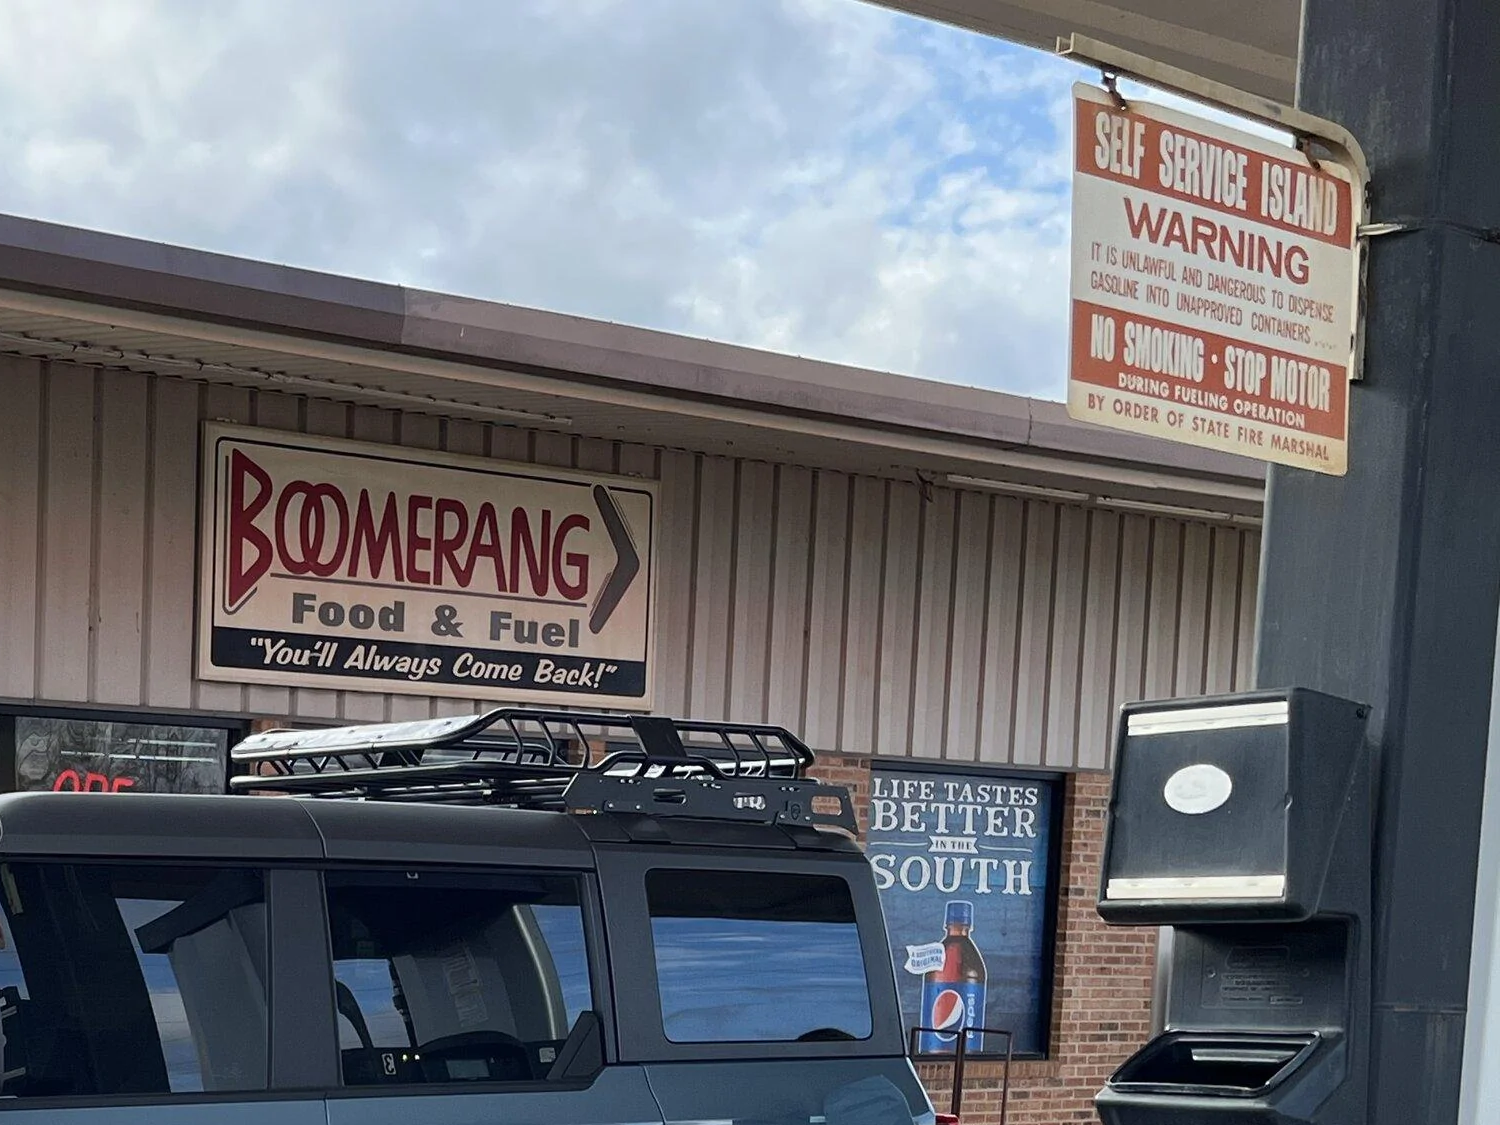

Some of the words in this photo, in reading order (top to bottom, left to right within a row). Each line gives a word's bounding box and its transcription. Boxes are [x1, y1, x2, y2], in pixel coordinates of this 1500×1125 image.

[1095, 111, 1145, 179] SELF
[1159, 129, 1247, 211] SERVICE
[1261, 161, 1337, 236] ISLAND
[1123, 196, 1309, 285] WARNING
[1091, 241, 1101, 262] IT
[1106, 245, 1117, 266] IS
[1122, 250, 1176, 282] UNLAWFUL
[1182, 266, 1202, 288] AND
[1207, 272, 1266, 305] DANGEROUS
[1272, 289, 1284, 310] TO
[1288, 294, 1334, 323] DISPENSE
[1091, 270, 1139, 300] GASOLINE
[1146, 284, 1170, 308] INTO
[1176, 291, 1243, 326] UNAPPROVED
[1251, 312, 1311, 344] CONTAINERS
[1091, 313, 1115, 362] NO
[1123, 320, 1205, 383] SMOKING
[1224, 345, 1267, 396] STOP
[1270, 355, 1330, 413] MOTOR
[1088, 393, 1104, 411] BY
[1113, 398, 1159, 424] ORDER
[1167, 410, 1184, 428] OF
[1192, 416, 1230, 438] STATE
[1238, 426, 1263, 447] FIRE
[1271, 434, 1330, 461] MARSHAL
[1118, 372, 1170, 398] DURING
[1174, 385, 1228, 411] FUELING
[1233, 398, 1305, 429] OPERATION
[227, 448, 590, 608] BOOMERANG
[292, 592, 405, 632] Food
[431, 605, 463, 638] &
[490, 611, 580, 648] Fuel
[344, 645, 441, 681] Always
[453, 652, 521, 683] Come
[871, 799, 1037, 838] BETTER
[873, 778, 935, 800] LIFE
[944, 782, 1038, 807] TASTES
[870, 854, 1033, 896] SOUTH
[935, 840, 947, 849] IN
[951, 841, 972, 851] THE
